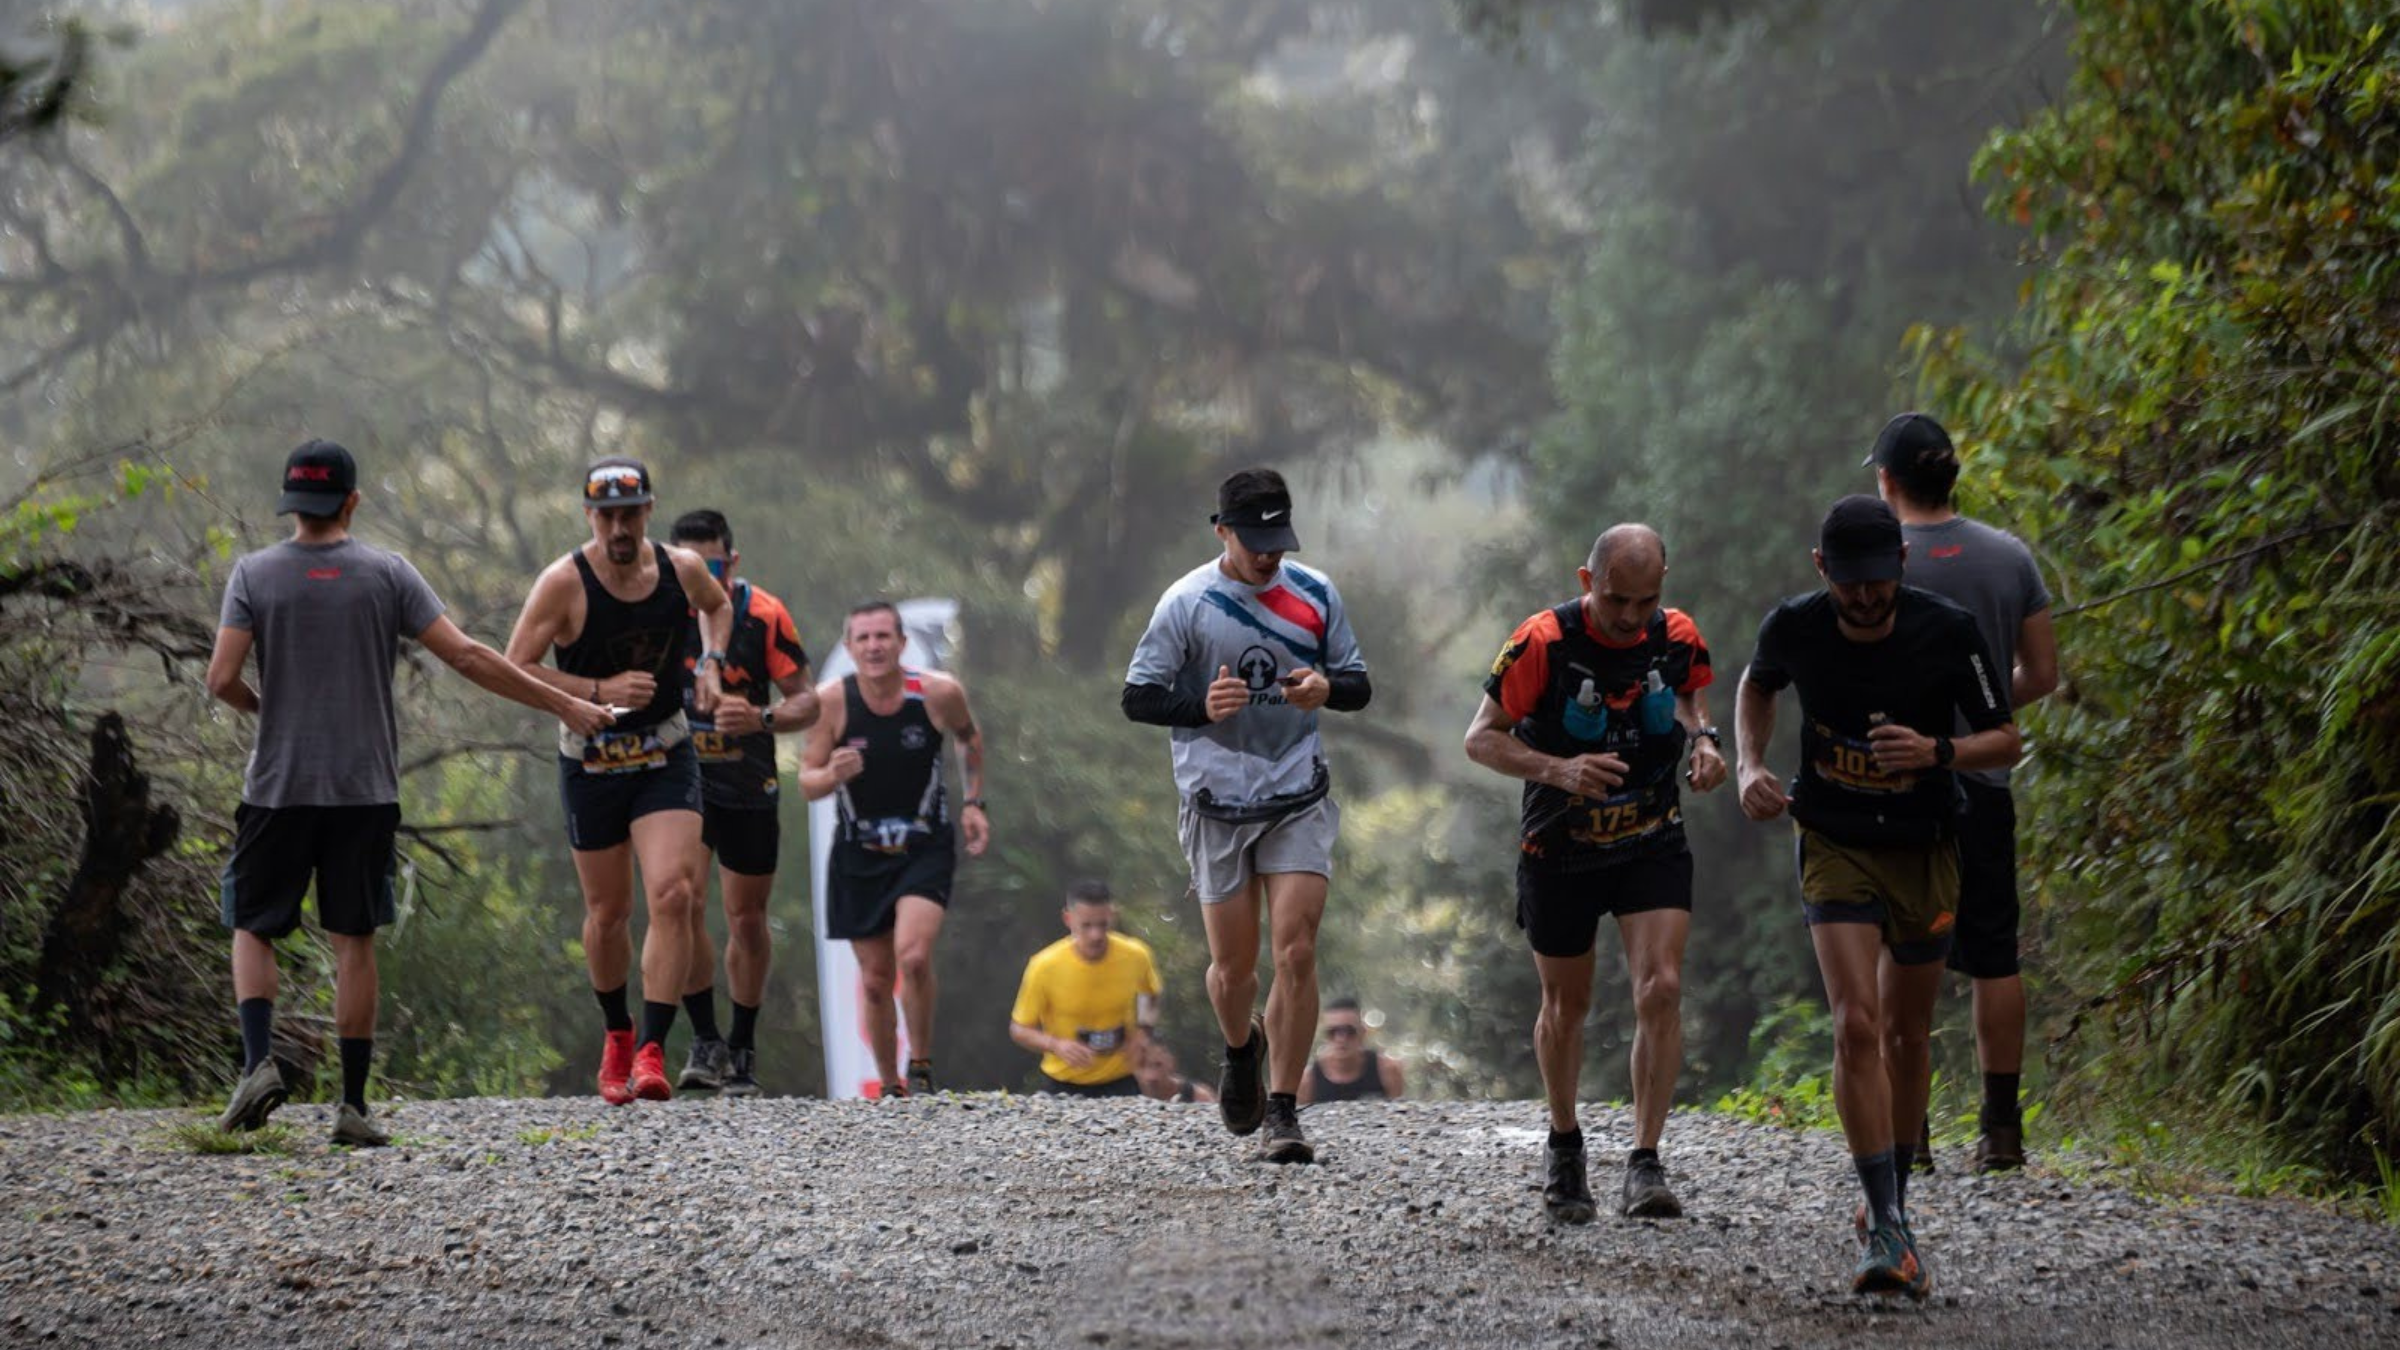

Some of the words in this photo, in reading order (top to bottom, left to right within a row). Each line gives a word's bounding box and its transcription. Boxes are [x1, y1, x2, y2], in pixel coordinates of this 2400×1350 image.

[1970, 654, 1997, 709] SALOMON
[1590, 802, 1638, 833] 175
[877, 824, 907, 847] 17
